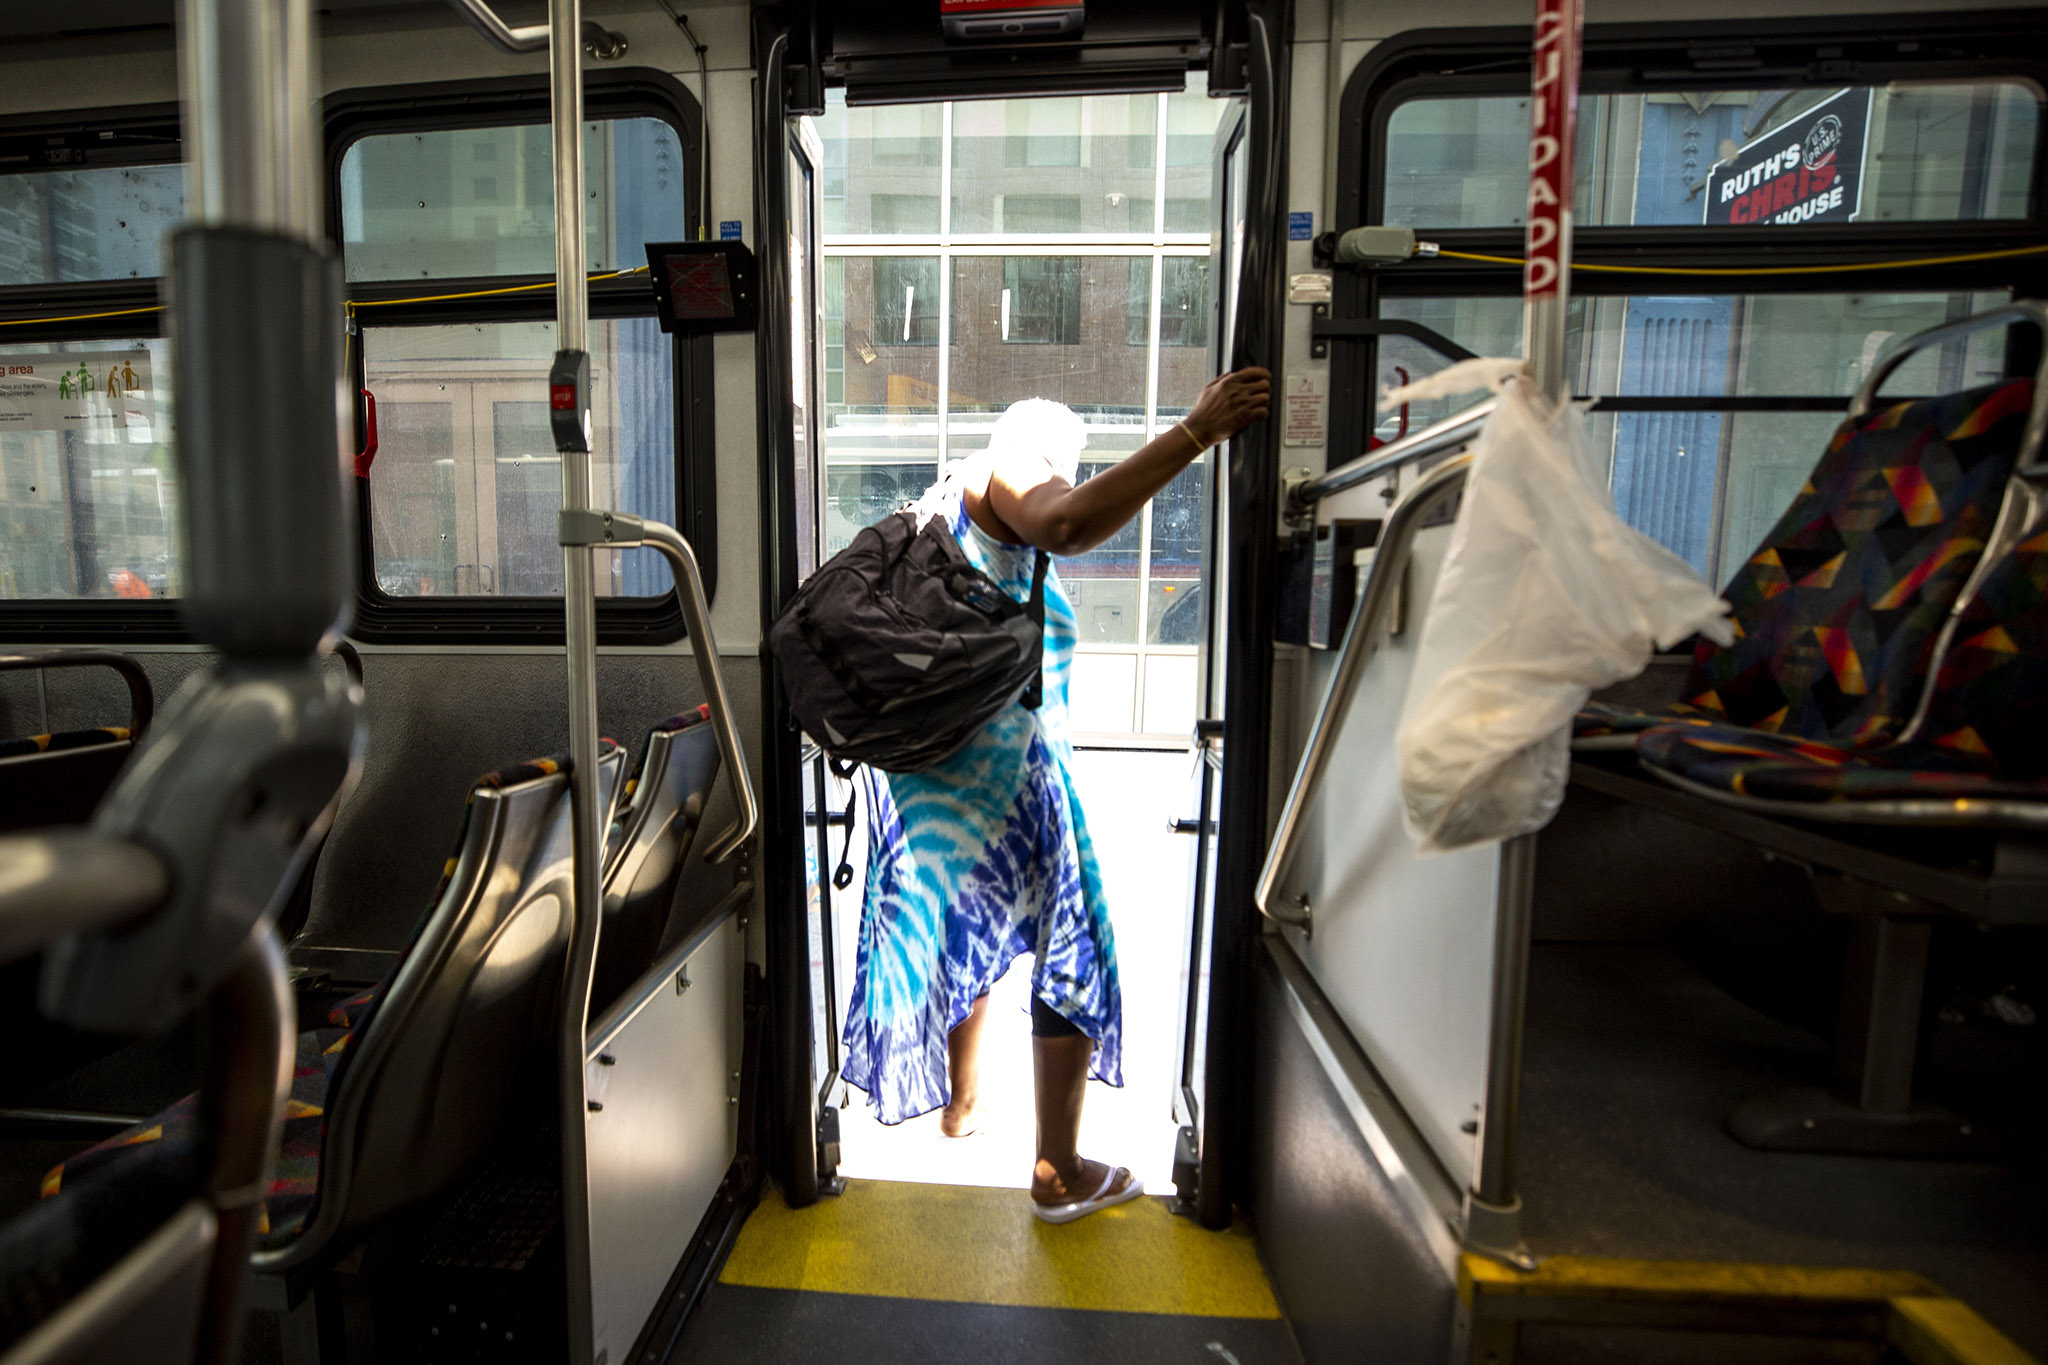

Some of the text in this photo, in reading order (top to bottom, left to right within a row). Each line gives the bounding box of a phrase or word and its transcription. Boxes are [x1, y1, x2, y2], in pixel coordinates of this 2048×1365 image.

[1808, 129, 1835, 165] PRIME
[1721, 143, 1800, 204] RUTH'S
[1729, 152, 1837, 225] CHRIS
[9, 365, 34, 375] area
